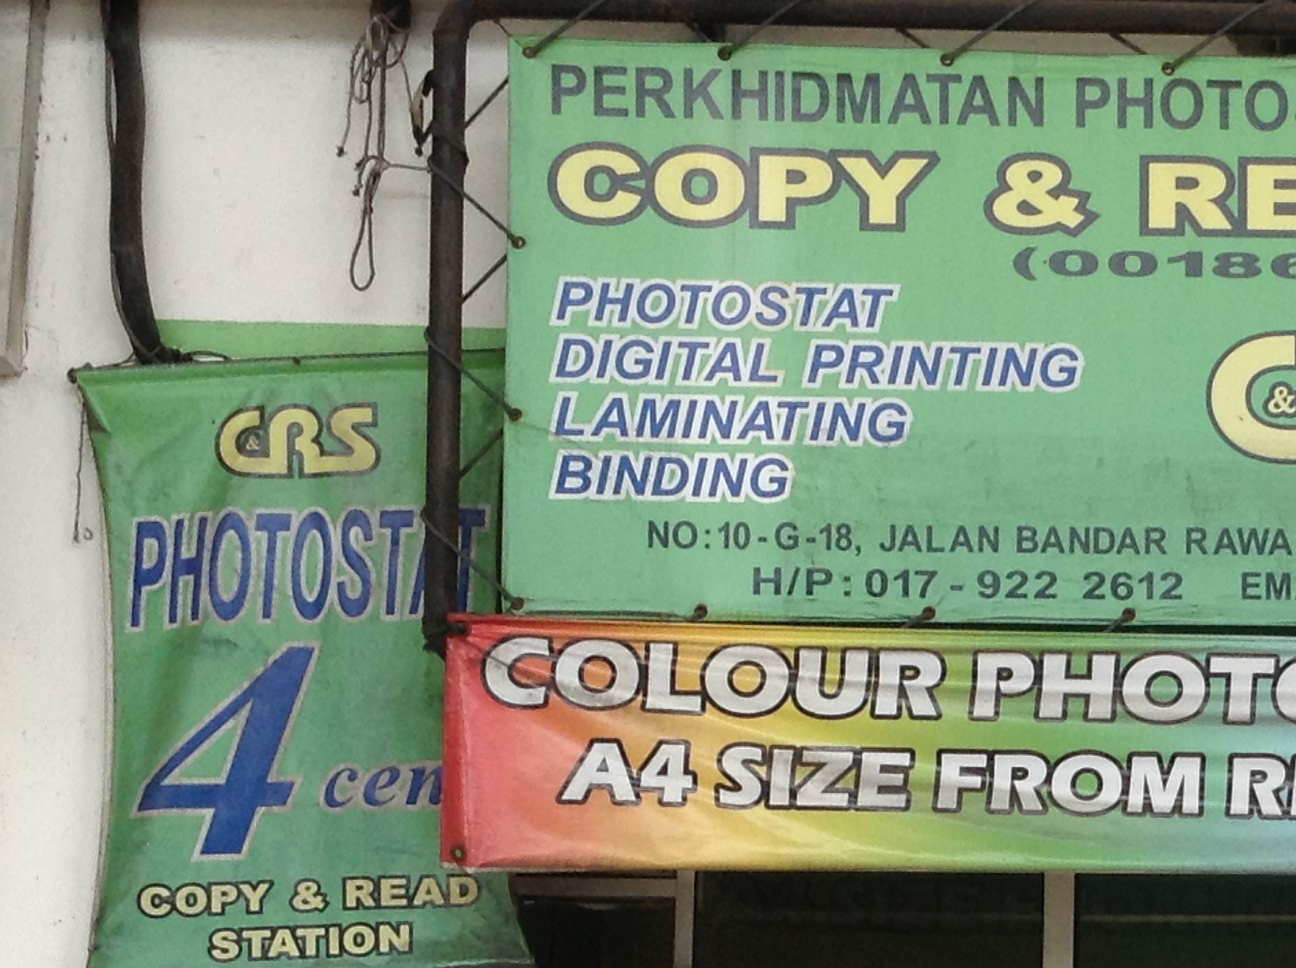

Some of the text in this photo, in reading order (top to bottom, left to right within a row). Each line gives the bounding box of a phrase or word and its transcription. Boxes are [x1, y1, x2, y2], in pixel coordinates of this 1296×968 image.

[548, 63, 1046, 129] PERKHIDMATAN
[548, 140, 940, 233] COPY
[986, 152, 1098, 237] &
[550, 276, 900, 330] PHOTOSTAT
[550, 336, 1086, 392] DIGITAL PRINTING
[550, 393, 915, 447] LAMINATING
[550, 452, 794, 502] BINDING
[877, 524, 1005, 556] JALAN
[1015, 526, 1168, 557] BANDAR
[1082, 570, 1184, 600] 2612
[481, 636, 943, 722] COLOUR
[132, 641, 322, 862] 4
[557, 738, 696, 809] A4
[715, 744, 915, 813] SIZE
[933, 749, 1205, 818] FROM
[138, 874, 481, 920] COPY & READ
[208, 923, 412, 962] STATION
